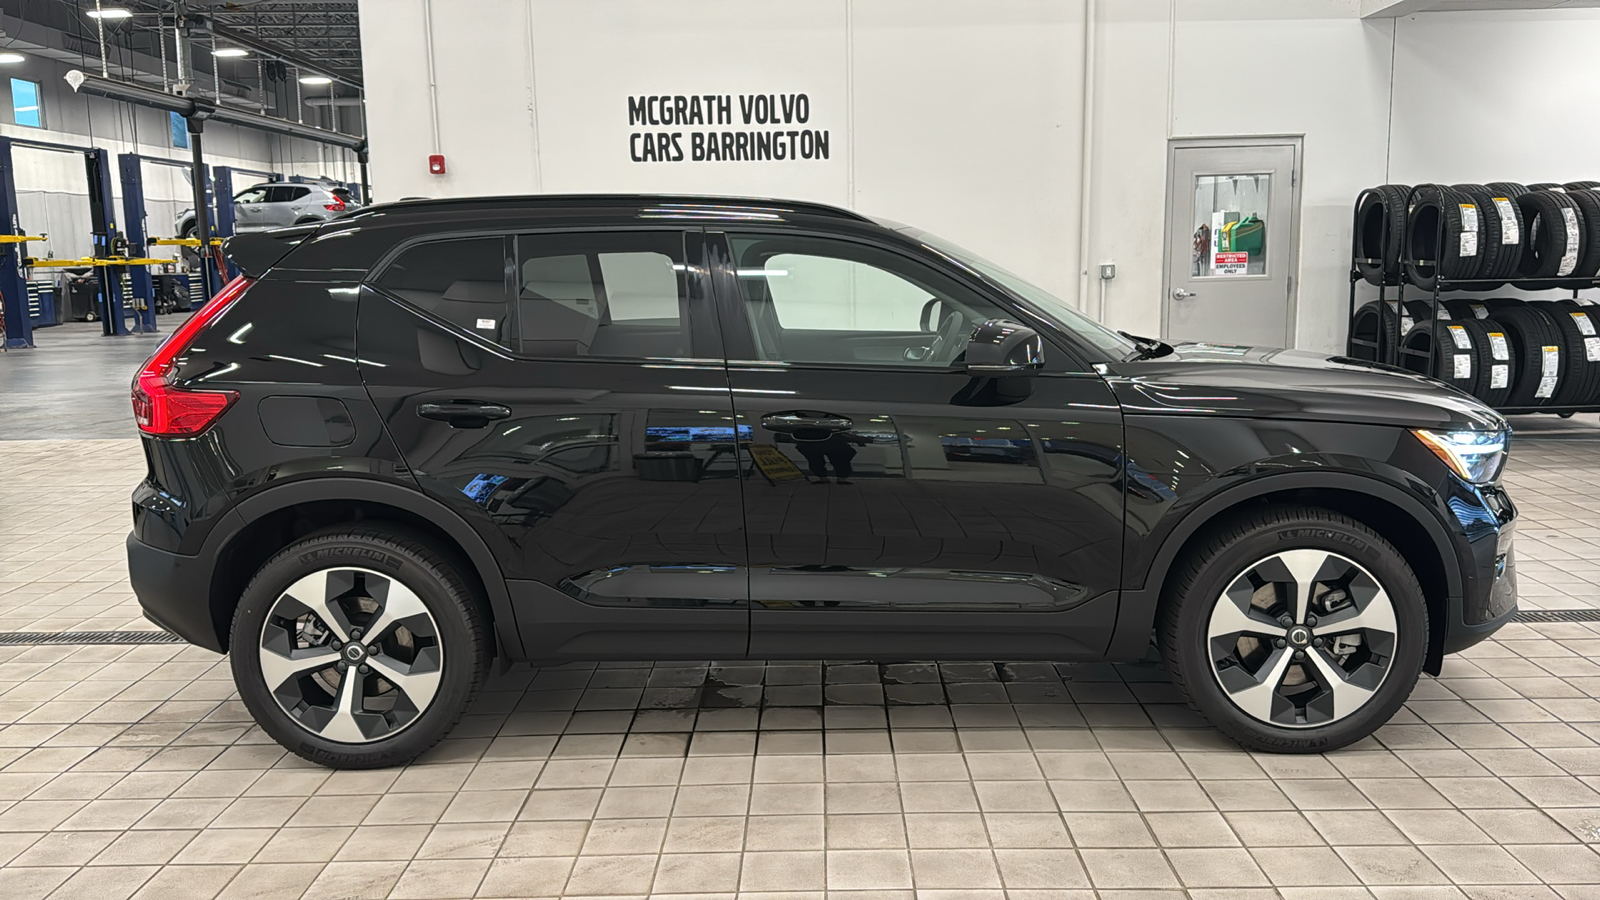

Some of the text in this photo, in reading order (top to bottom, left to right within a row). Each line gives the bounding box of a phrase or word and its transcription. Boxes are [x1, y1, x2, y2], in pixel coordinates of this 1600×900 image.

[628, 93, 810, 126] MCGRATH VOLVO
[629, 129, 830, 162] CARS BARRINGTON
[317, 546, 386, 562] MICHELIN
